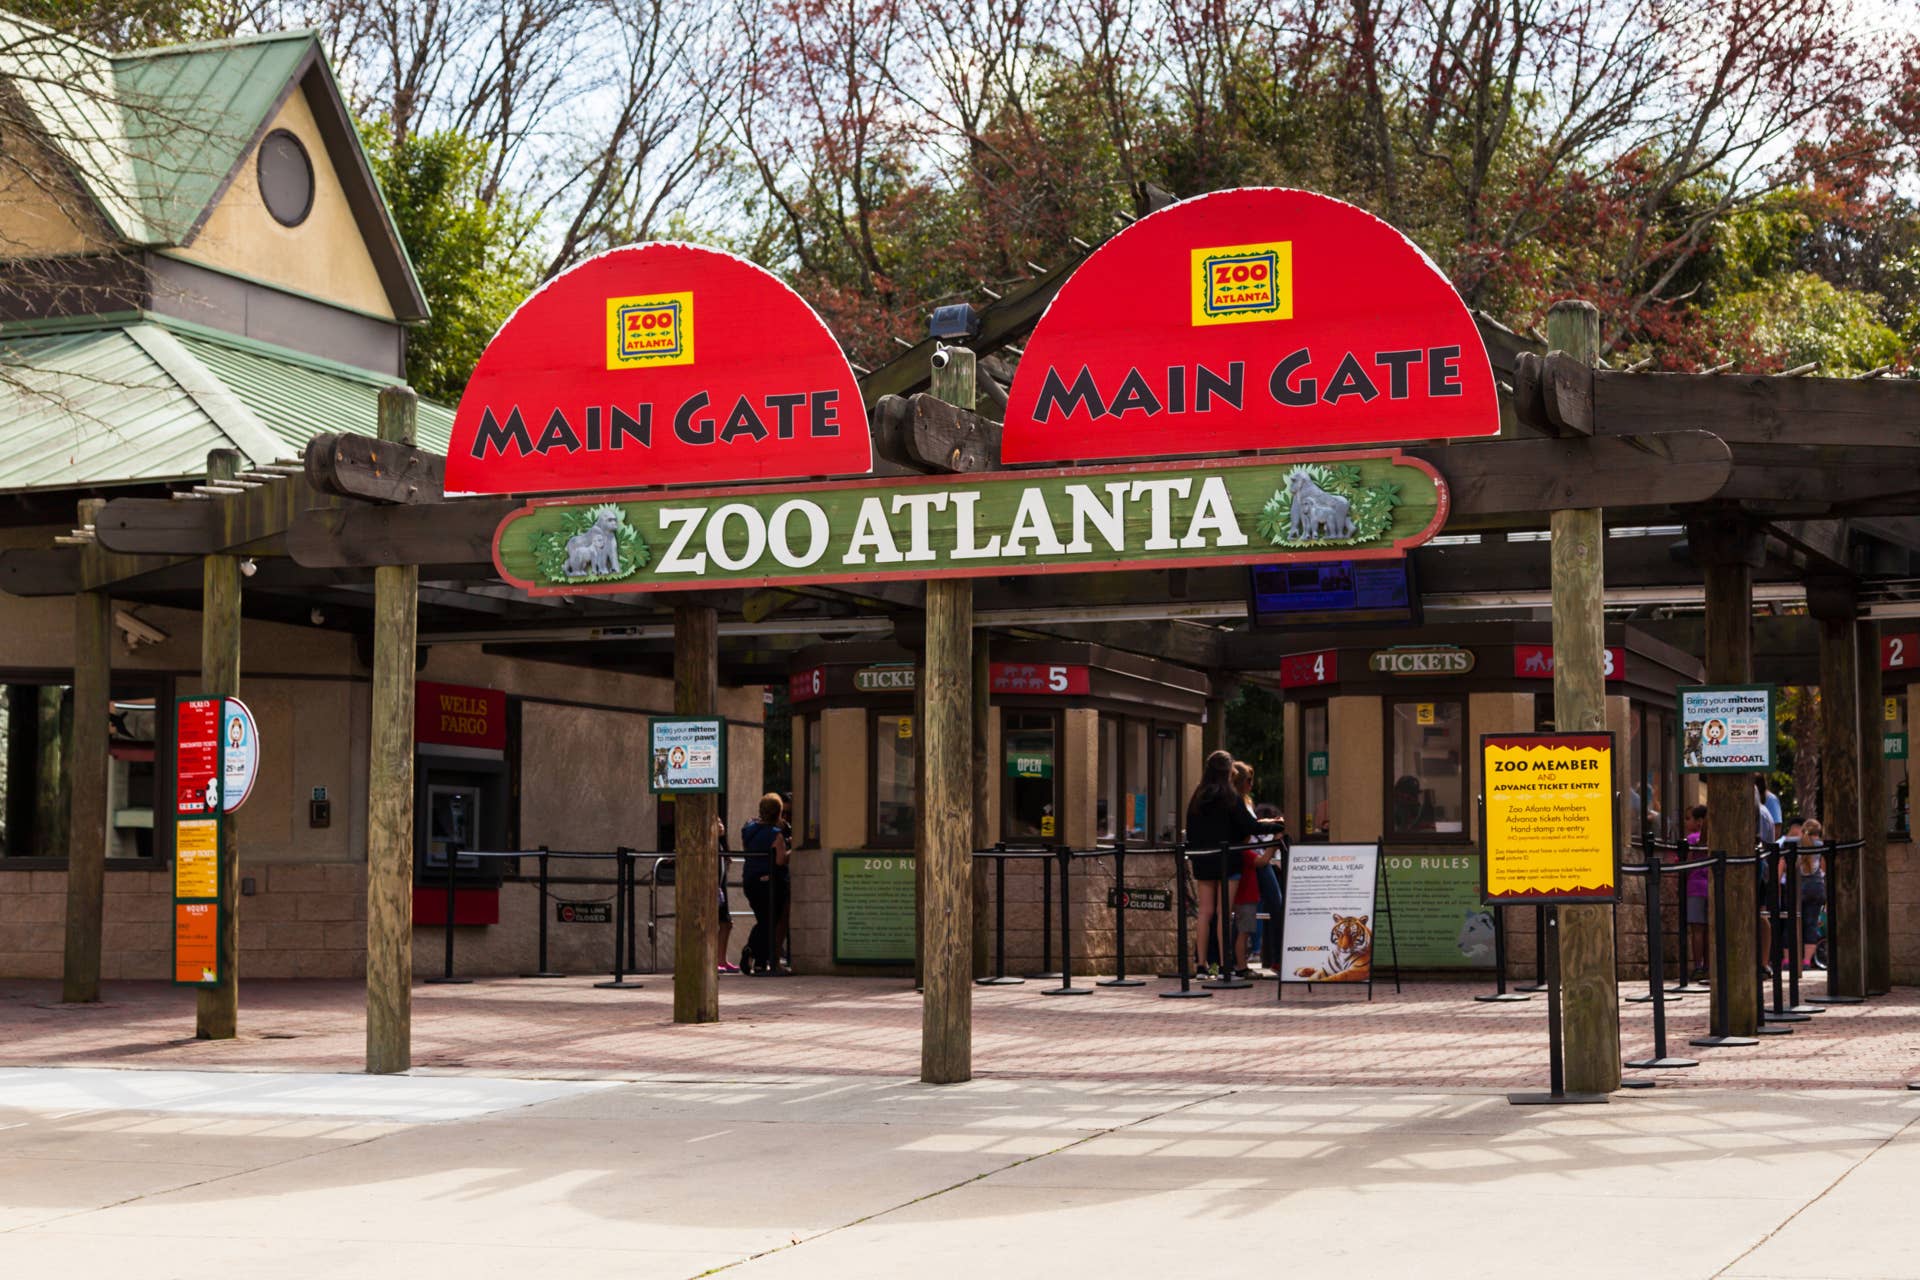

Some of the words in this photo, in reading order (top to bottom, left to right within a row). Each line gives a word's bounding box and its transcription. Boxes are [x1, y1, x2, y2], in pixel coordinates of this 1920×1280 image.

[1216, 264, 1268, 284] ZOO
[1215, 292, 1269, 304] ATLANTA
[628, 313, 672, 331] ZOO
[627, 339, 674, 349] ATLANTA
[1031, 360, 1245, 424] MAIN
[1268, 345, 1463, 408] GATE
[470, 402, 653, 460] MAIN
[673, 389, 840, 446] GATE
[654, 499, 830, 575] ZOO
[842, 476, 1248, 565] ATLANTA
[1889, 638, 1904, 666] 2
[1313, 655, 1325, 682] 4
[1376, 652, 1467, 671] TICKETS
[812, 673, 820, 695] 6
[859, 671, 915, 687] TICKE
[1048, 666, 1069, 692] 5
[440, 694, 488, 716] WELLS
[1686, 697, 1708, 705] Bring
[1728, 695, 1765, 704] mittens
[440, 714, 488, 735] FARGO
[656, 727, 673, 735] Bring
[1883, 738, 1902, 753] OPEN
[1017, 757, 1042, 773] OPEN
[1495, 761, 1528, 772] ZOO
[1532, 759, 1599, 771] MEMBER
[1494, 783, 1536, 791] ADVANCE
[1571, 782, 1600, 790] ENTRY
[1509, 805, 1523, 813] Zoo
[1525, 804, 1551, 812] Atlanta
[1553, 803, 1586, 812] Members
[1506, 815, 1537, 823] Advance
[1539, 814, 1561, 822] tickets
[1563, 813, 1590, 822] holders
[864, 859, 893, 870] ZOO
[1421, 857, 1469, 869] RULES
[1130, 901, 1165, 909] CLOSED
